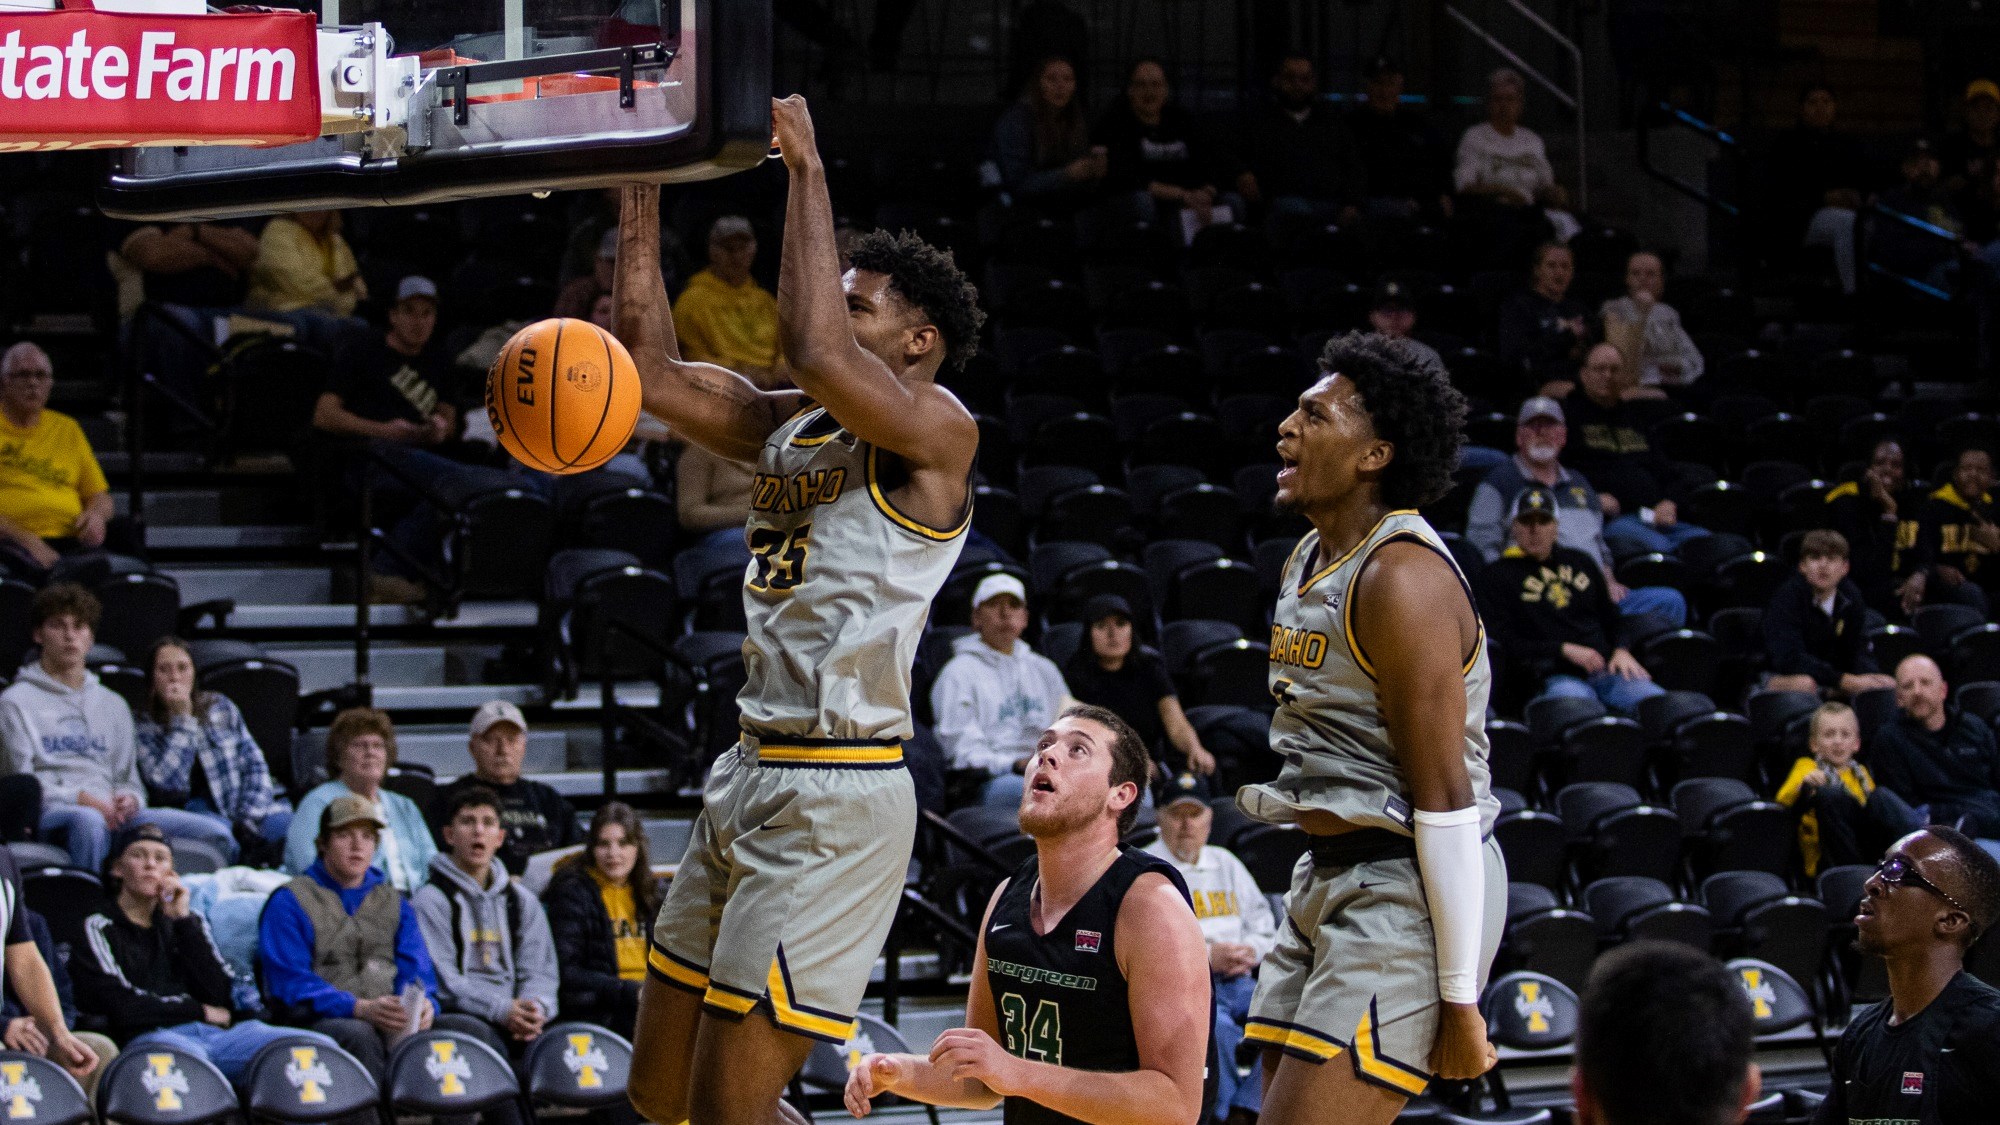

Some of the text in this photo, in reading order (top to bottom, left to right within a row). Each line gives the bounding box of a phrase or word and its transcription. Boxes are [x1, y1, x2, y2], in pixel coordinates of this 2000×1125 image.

[0, 28, 296, 102] tate Farm
[516, 348, 538, 408] EVO
[751, 467, 848, 514] IDAHO
[1520, 564, 1591, 602] IDAHO
[1000, 991, 1063, 1067] 34
